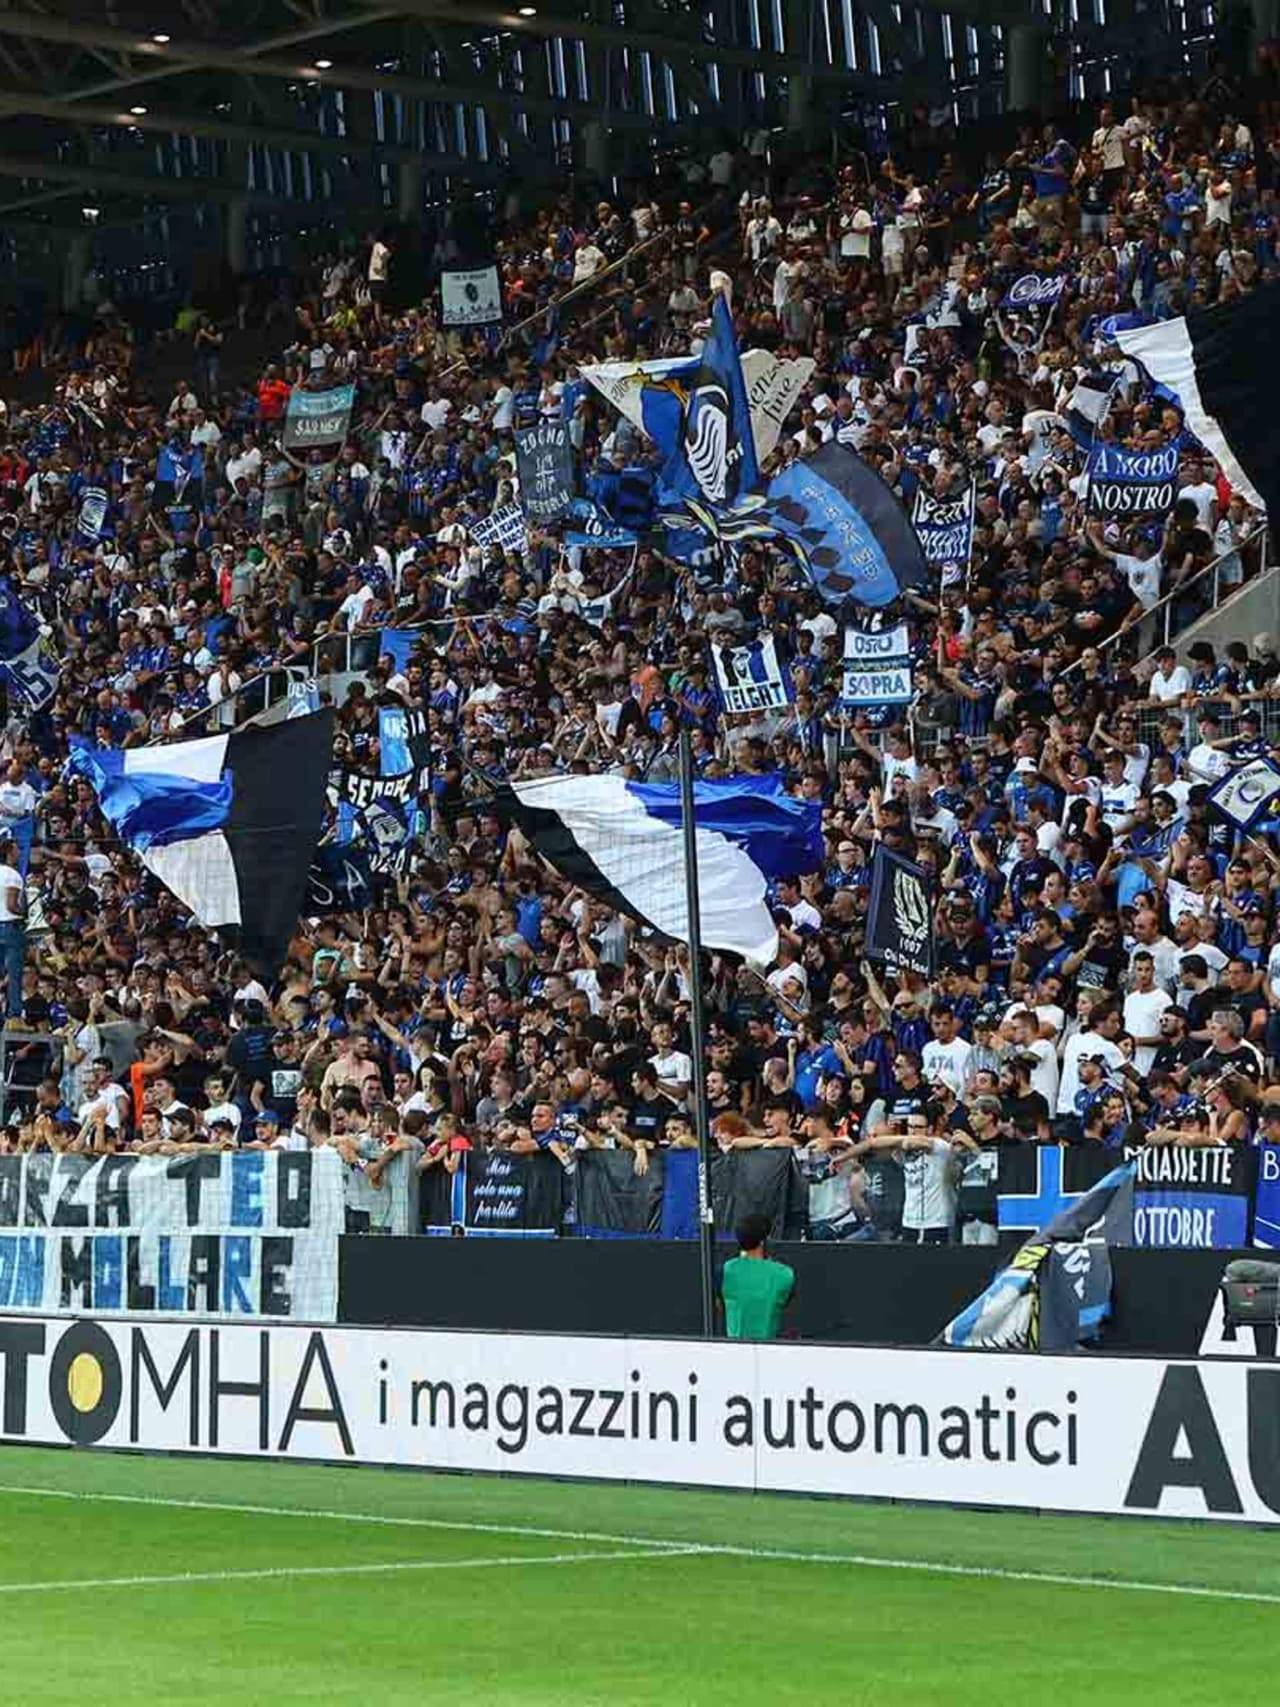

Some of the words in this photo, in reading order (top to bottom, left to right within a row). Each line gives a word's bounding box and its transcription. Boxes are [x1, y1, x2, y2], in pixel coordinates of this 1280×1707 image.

[763, 376, 796, 425] fine
[1094, 448, 1108, 473] A
[1089, 483, 1173, 511] NOSTRO
[848, 674, 906, 696] SOPRA
[486, 1158, 511, 1176] Mai
[167, 1151, 312, 1228] TEO
[474, 1179, 496, 1196] solo
[498, 1185, 523, 1196] una
[474, 1200, 518, 1224] partita
[1134, 1207, 1216, 1247] OTTOBRE
[59, 1234, 294, 1315] MOLLARE
[0, 1319, 355, 1456] TOMHA
[379, 1358, 388, 1425] i
[411, 1369, 698, 1454] magazzini
[723, 1386, 1078, 1466] automatici
